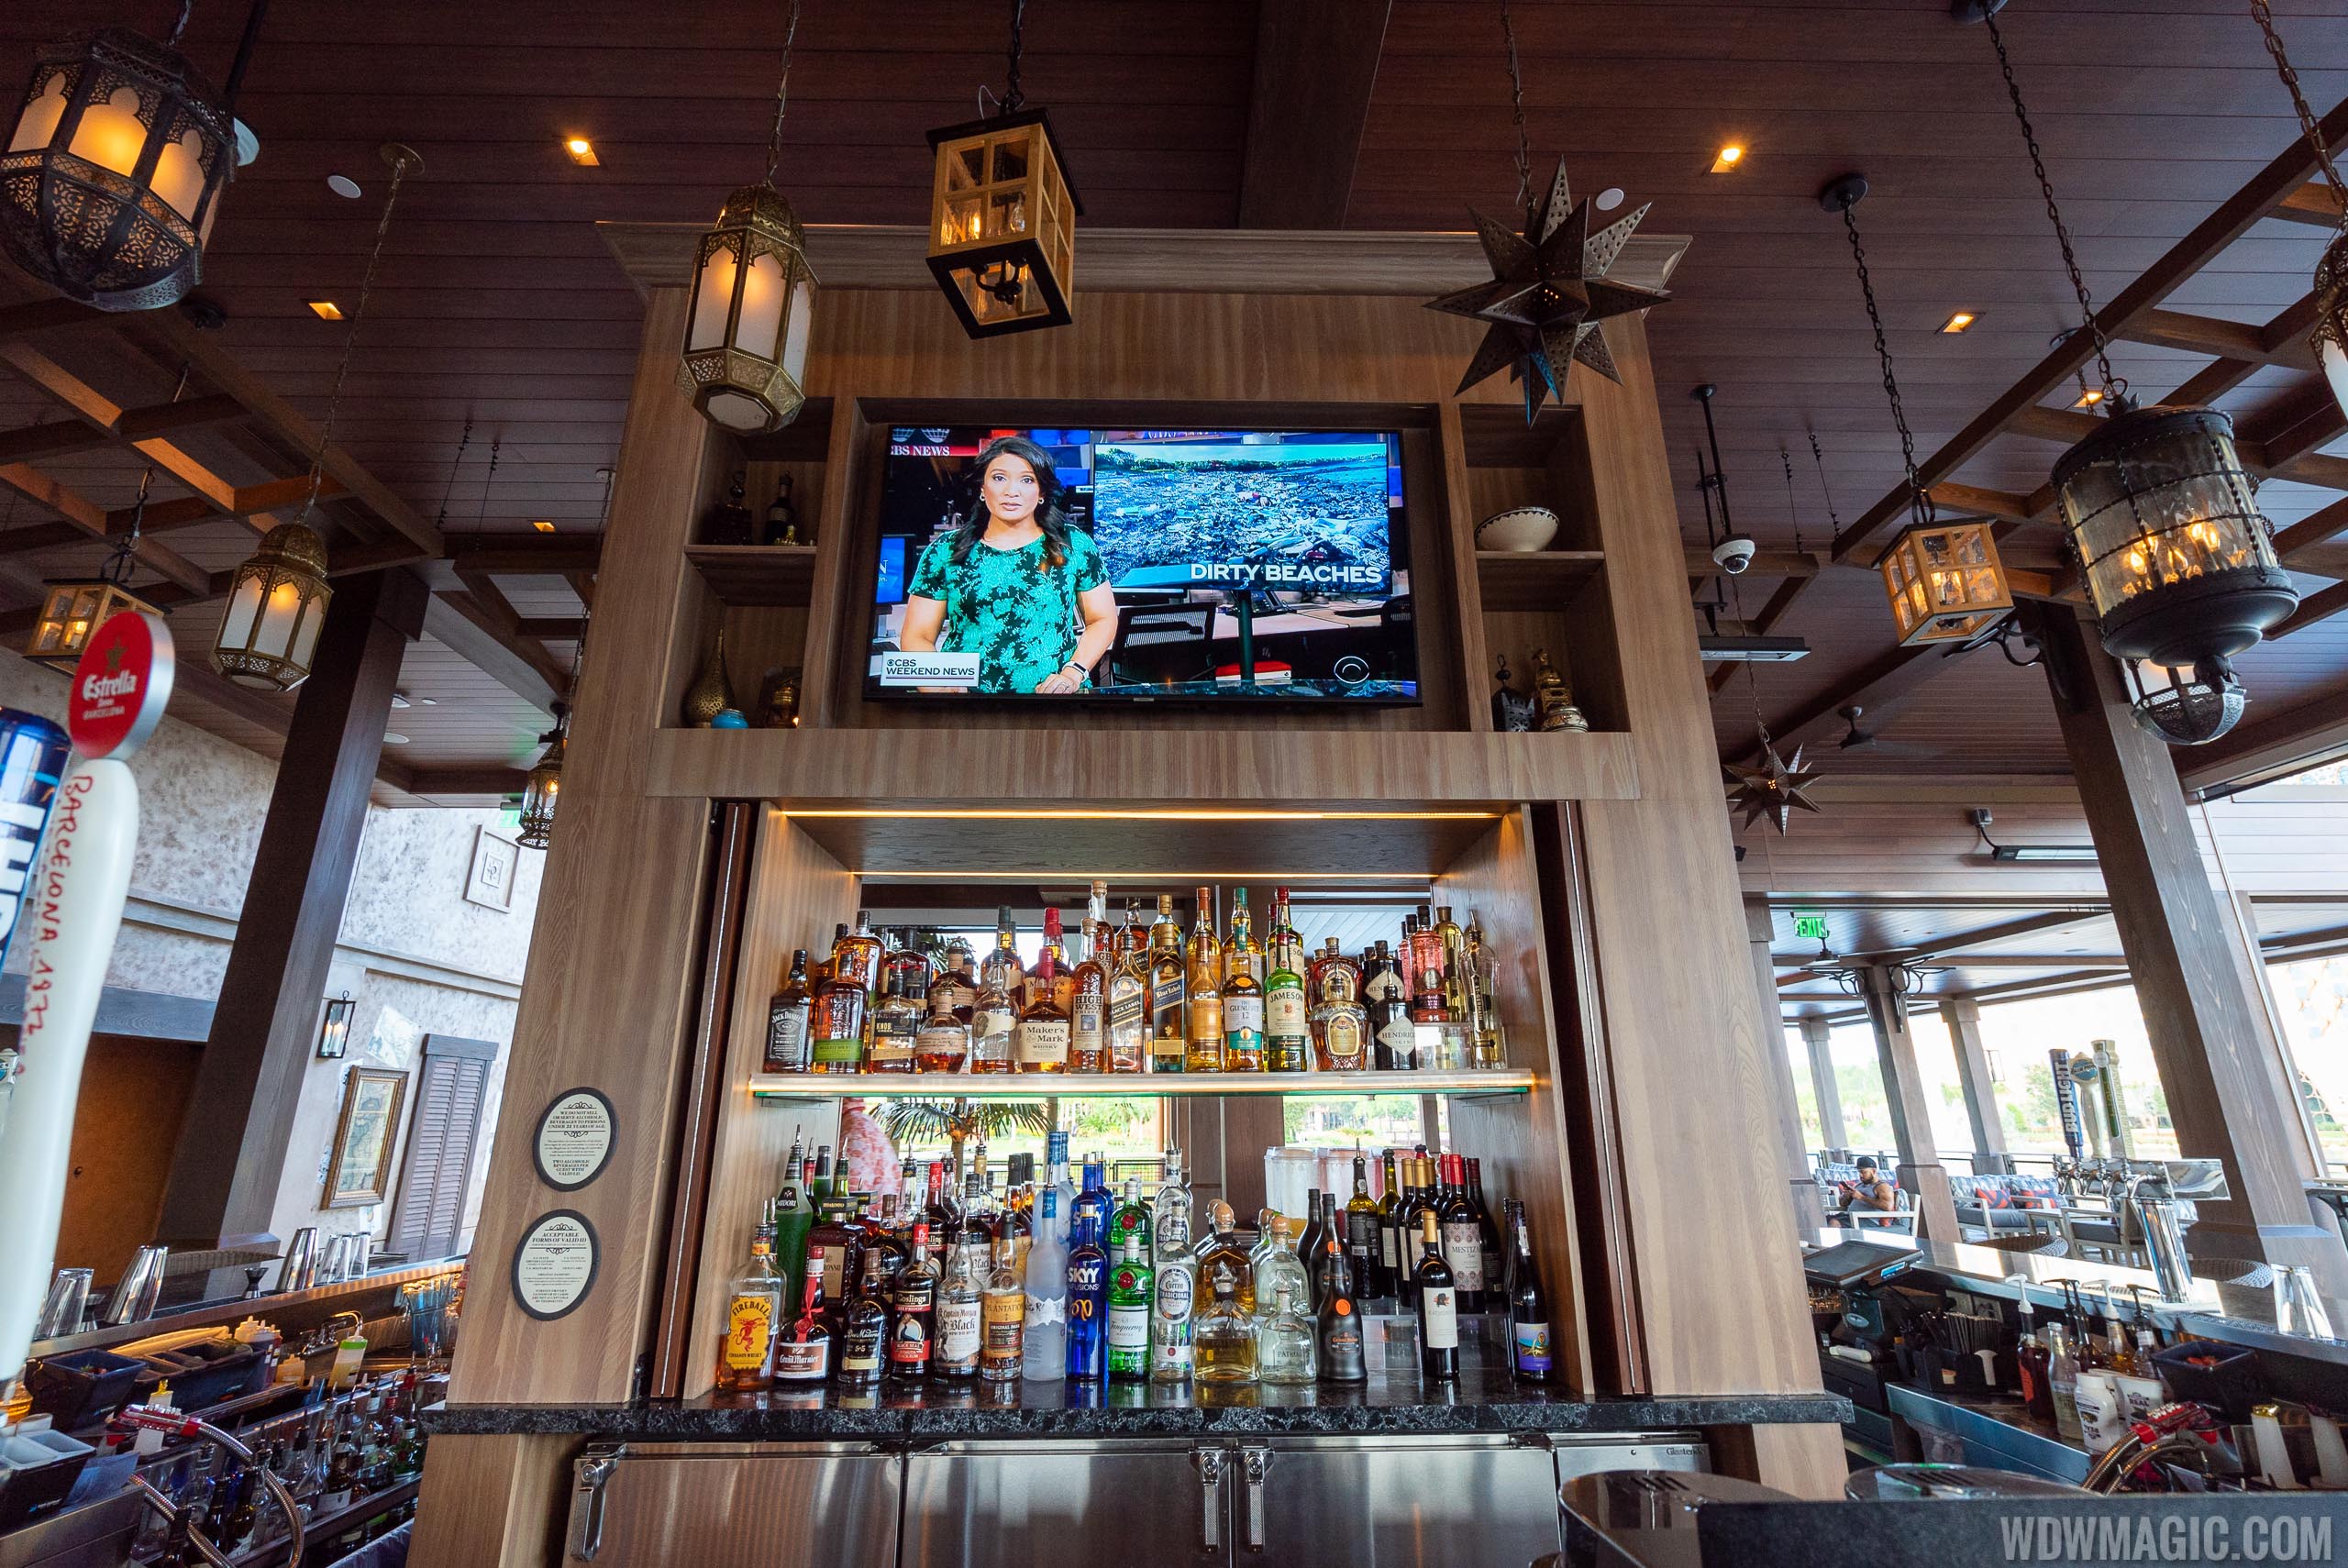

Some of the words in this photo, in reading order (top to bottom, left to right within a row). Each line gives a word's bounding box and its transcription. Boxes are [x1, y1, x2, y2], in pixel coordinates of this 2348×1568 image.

[913, 446, 950, 457] NEWS
[1191, 563, 1260, 580] DIRTY
[1265, 564, 1382, 584] BEACHES
[894, 658, 916, 668] CBS
[886, 667, 941, 676] WEEKEND
[943, 668, 975, 676] NEWS
[82, 669, 138, 701] Estrella
[1799, 918, 1822, 937] EXIT
[1156, 988, 1168, 999] Blue
[1168, 984, 1181, 992] Label
[1269, 991, 1303, 1003] JAMESON
[1075, 996, 1102, 1004] HIGH
[1124, 999, 1141, 1010] LABEL
[771, 1012, 785, 1024] JACK
[1026, 1026, 1065, 1034] Maker's
[1037, 1034, 1064, 1043] Mark
[2054, 1062, 2075, 1103] LIGHT
[2062, 1102, 2079, 1133] BUD
[777, 1198, 797, 1207] MIDORI
[1068, 1267, 1100, 1284] SKYY
[897, 1294, 926, 1304] Goslings
[732, 1300, 770, 1317] FIREBALL
[948, 1318, 976, 1331] Black
[1110, 1321, 1143, 1332] Tanqueray
[792, 1353, 819, 1364] Marnier
